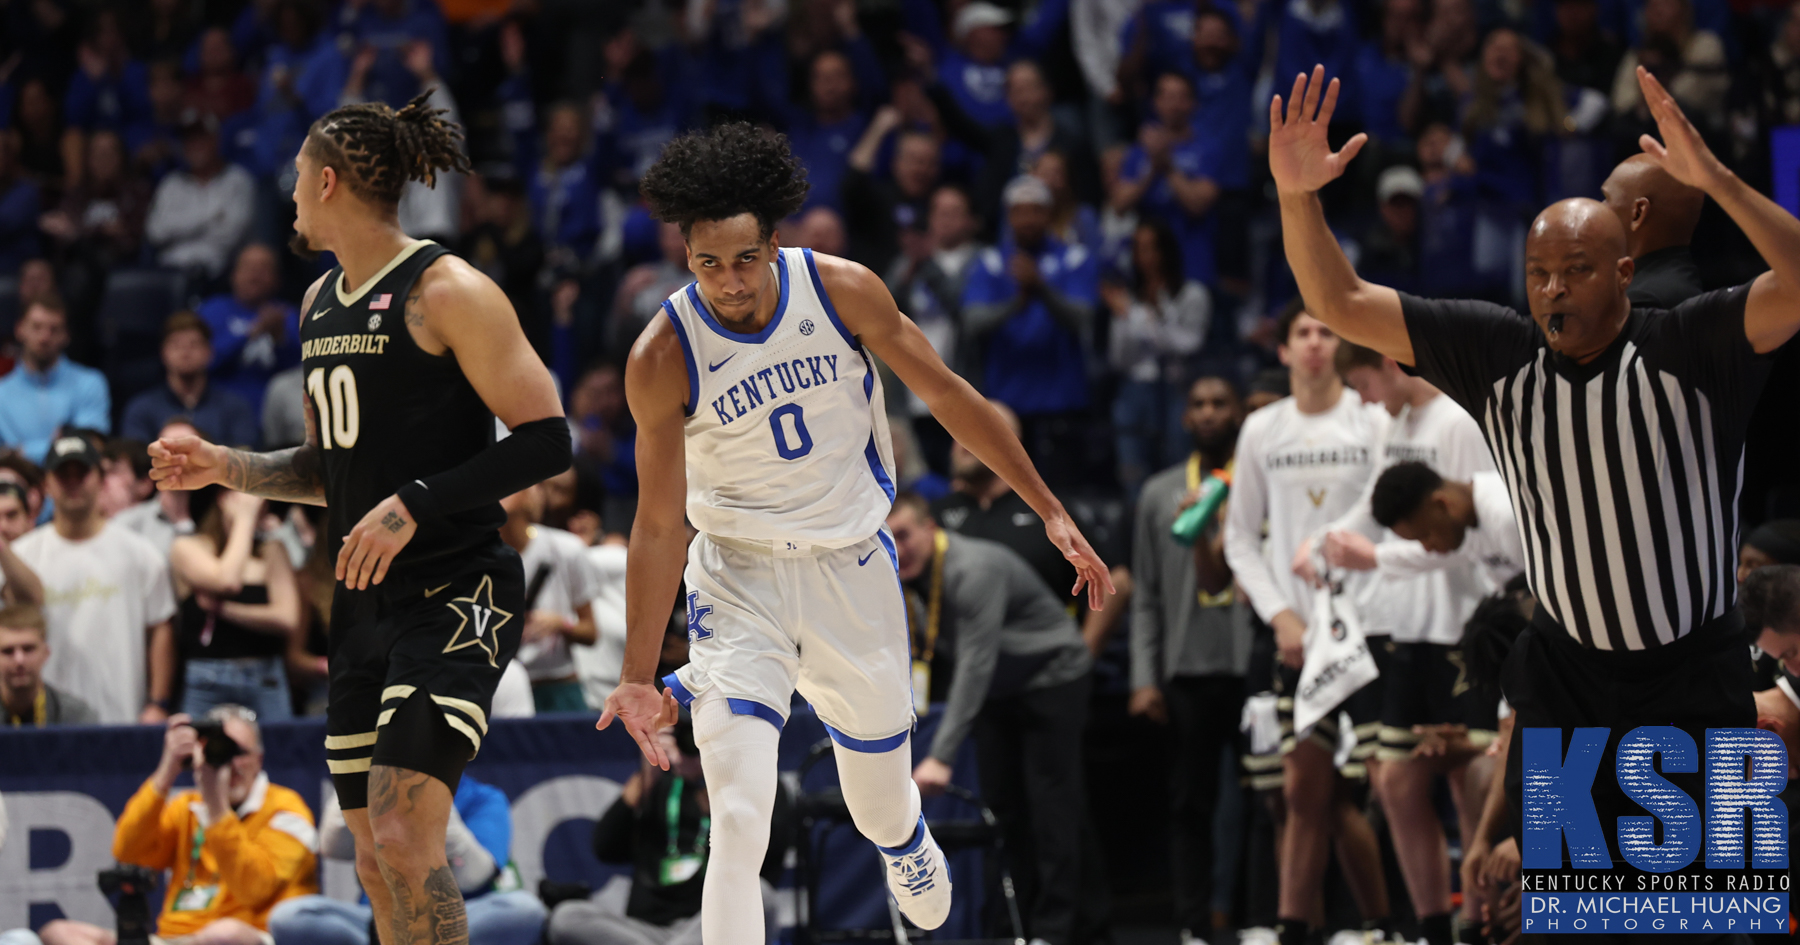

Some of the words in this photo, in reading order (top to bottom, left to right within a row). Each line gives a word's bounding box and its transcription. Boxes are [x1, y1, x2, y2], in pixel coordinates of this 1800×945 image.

[799, 319, 815, 336] SEC
[307, 364, 360, 450] 10
[711, 354, 838, 426] KENTUCKY
[768, 403, 814, 461] 0
[472, 603, 492, 638] V
